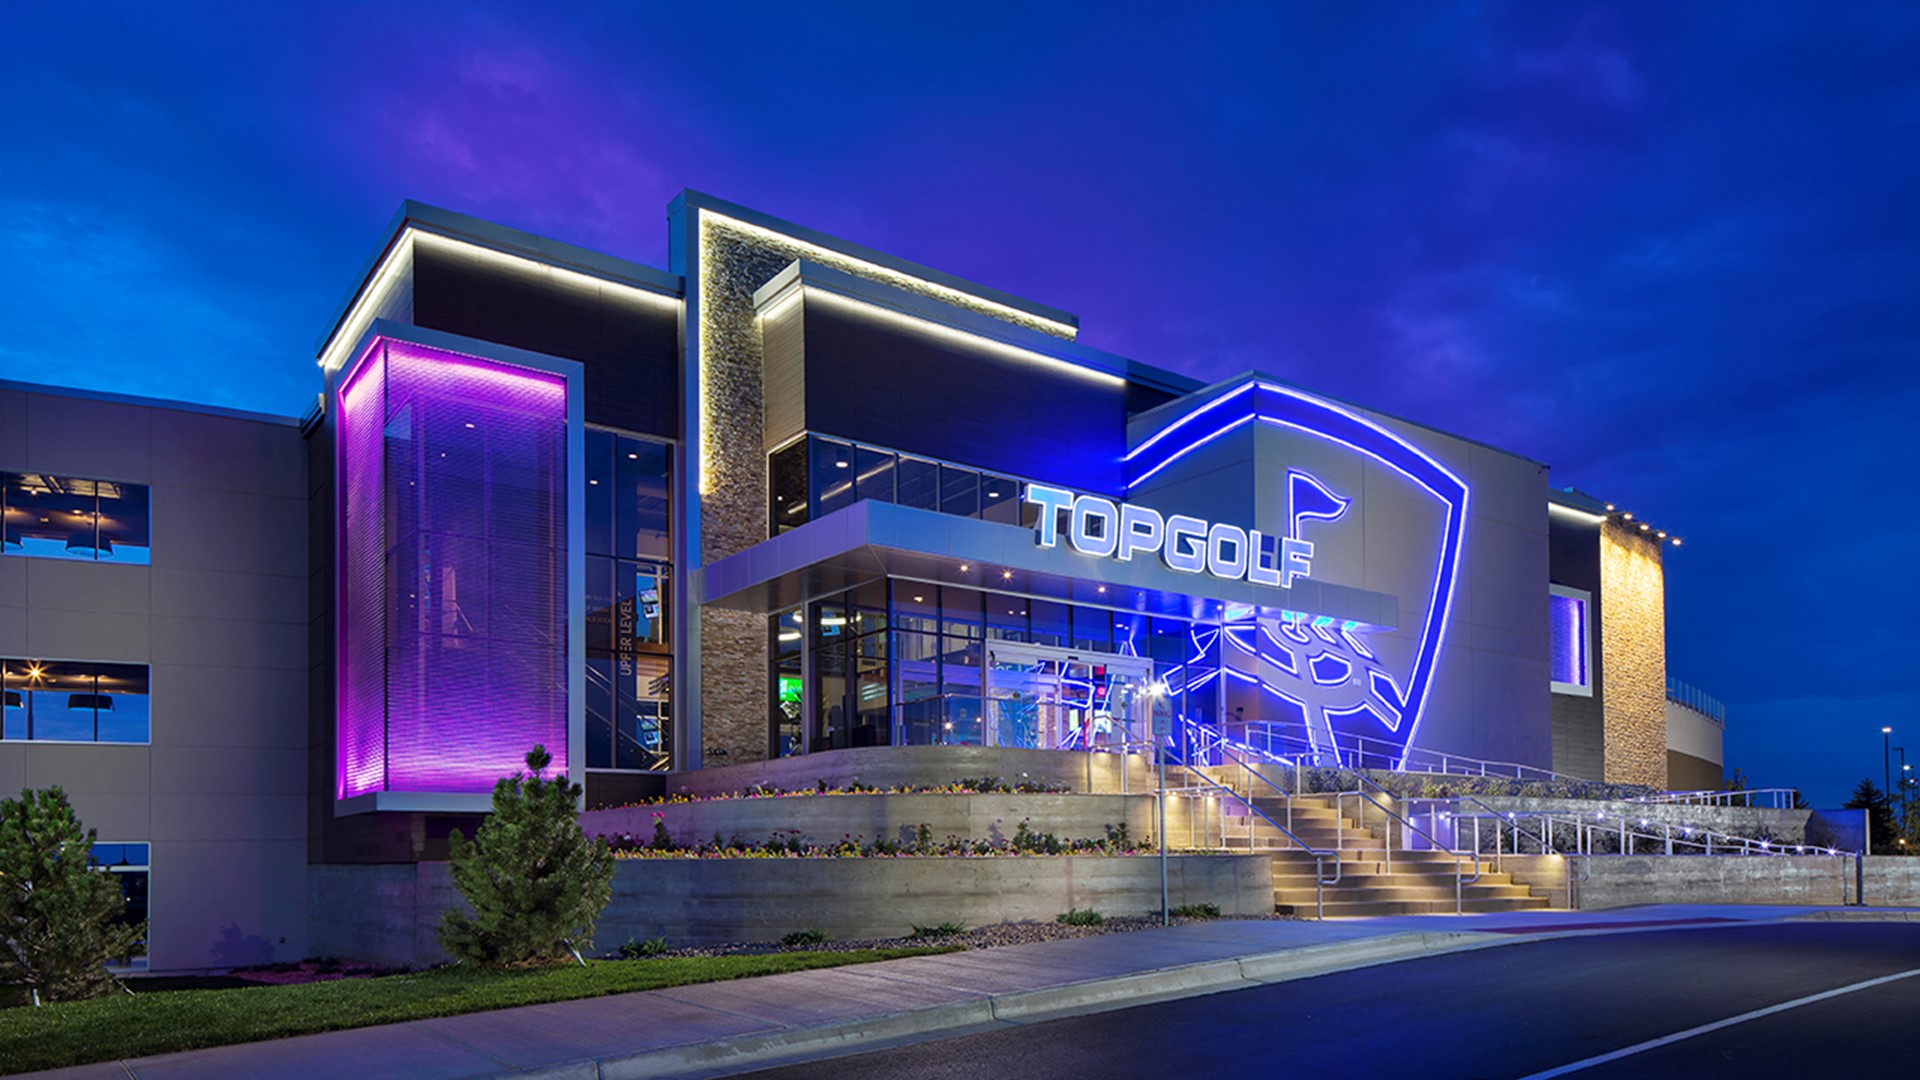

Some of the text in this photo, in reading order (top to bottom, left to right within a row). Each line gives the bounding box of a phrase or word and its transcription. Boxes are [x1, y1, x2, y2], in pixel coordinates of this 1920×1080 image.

[1025, 483, 1314, 588] TOPGOLF
[620, 599, 632, 677] UPPER LEVEL
